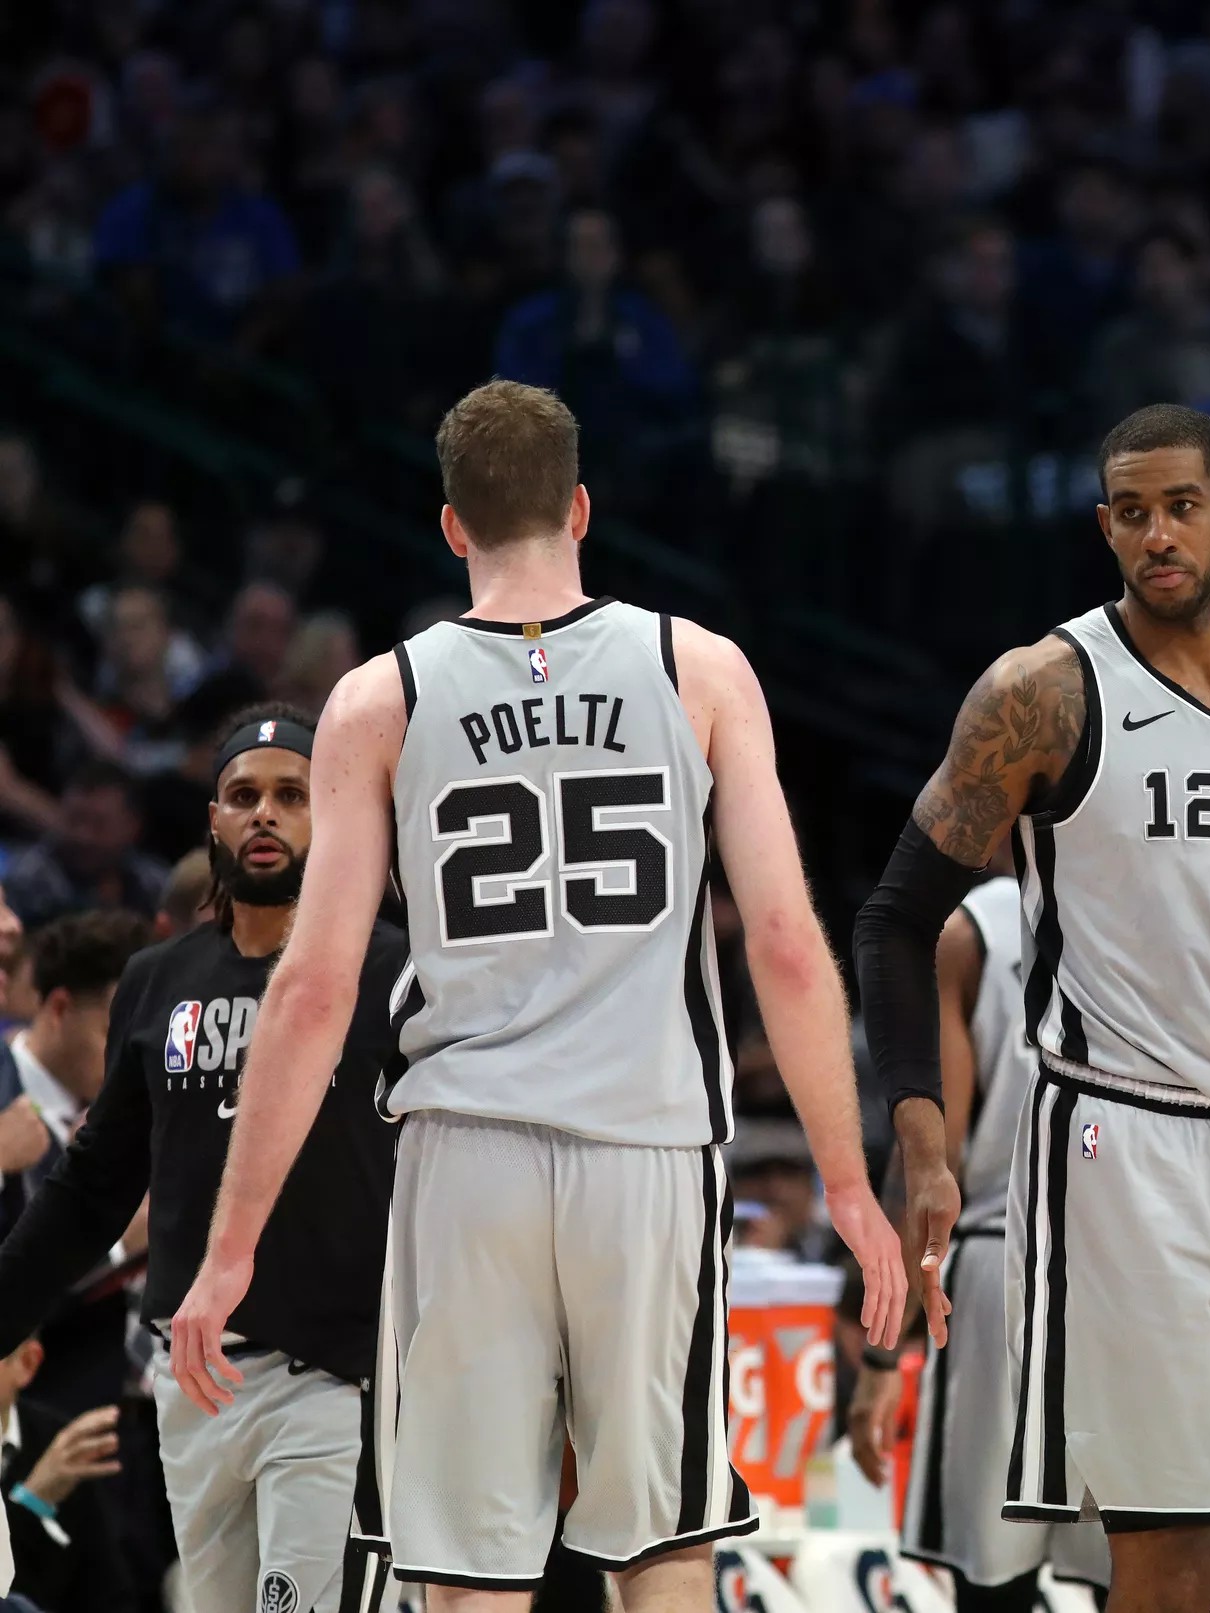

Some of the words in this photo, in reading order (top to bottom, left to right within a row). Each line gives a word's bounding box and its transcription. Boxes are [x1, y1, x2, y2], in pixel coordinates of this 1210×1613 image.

[460, 694, 626, 765] POELTL
[429, 766, 674, 948] 25
[168, 1055, 182, 1068] NBA
[197, 997, 259, 1071] SP
[729, 1347, 766, 1416] G
